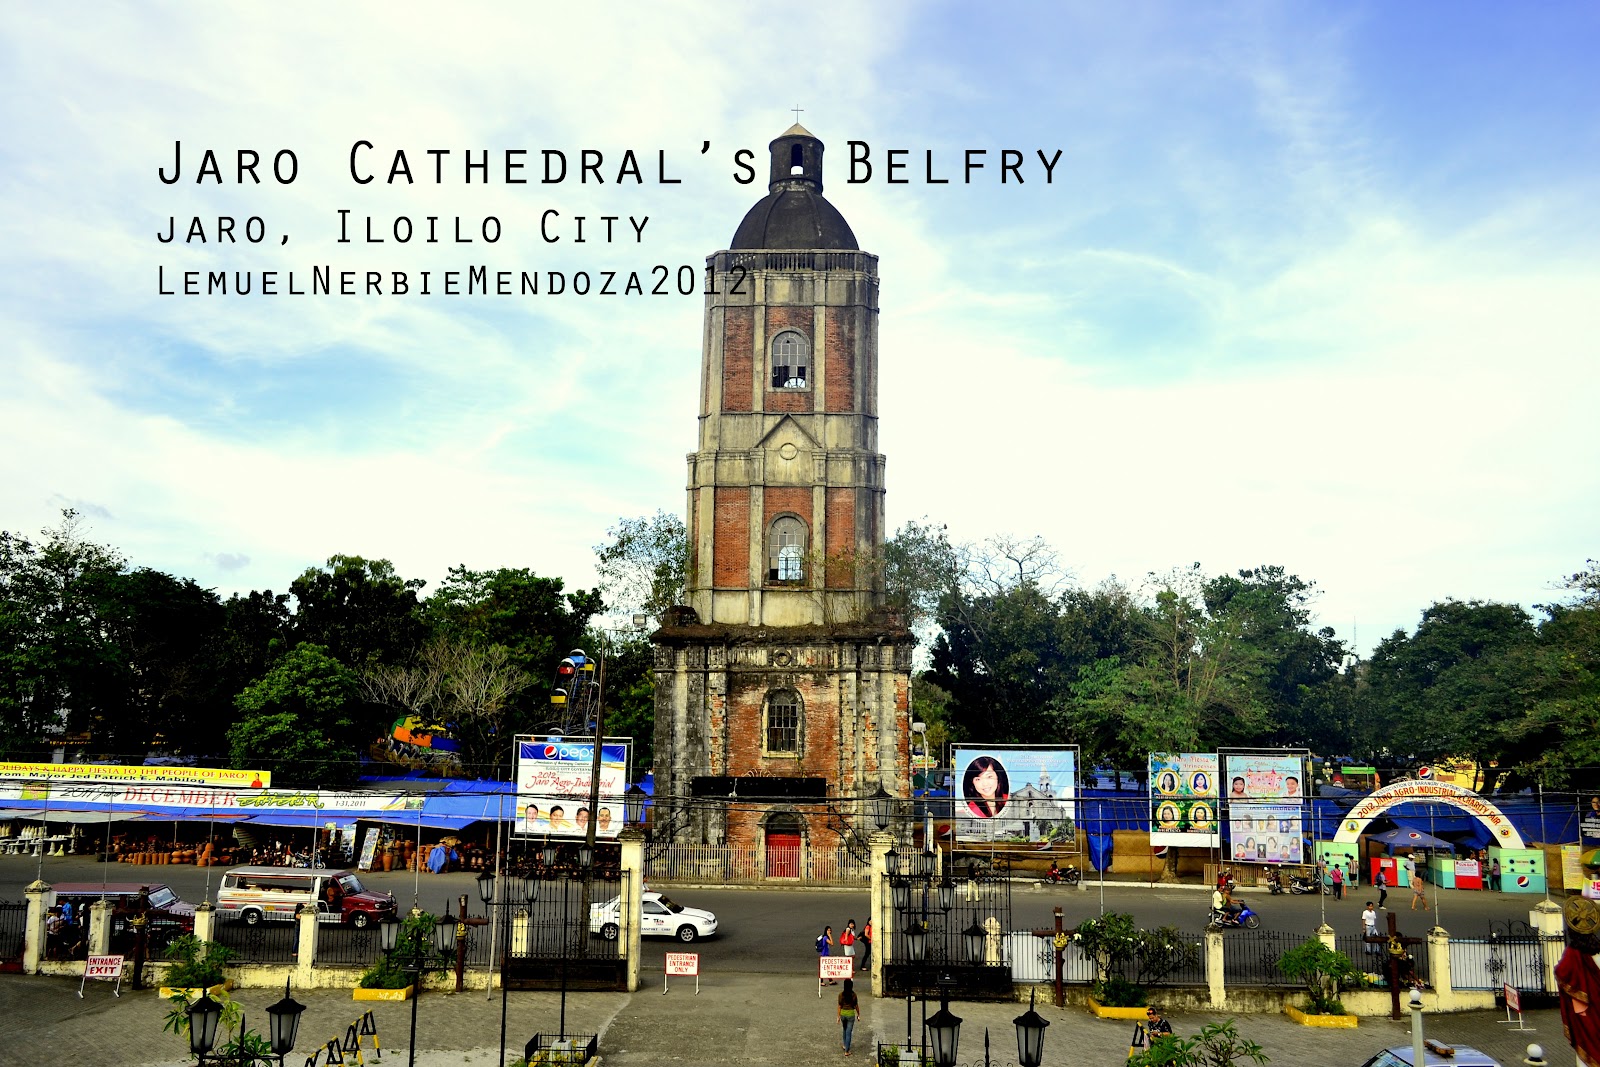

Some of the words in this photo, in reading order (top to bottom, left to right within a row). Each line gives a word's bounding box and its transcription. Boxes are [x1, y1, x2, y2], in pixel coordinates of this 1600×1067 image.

[29, 772, 66, 780] Mayor
[155, 776, 206, 784] Mabilog
[124, 786, 237, 806] DECEMBER
[1357, 802, 1376, 818] 2012
[1374, 792, 1393, 807] JARO
[1462, 795, 1490, 814] CHARITY
[1487, 811, 1502, 826] FAIR
[89, 957, 122, 966] ENTRANCE
[89, 966, 117, 975] EXIT
